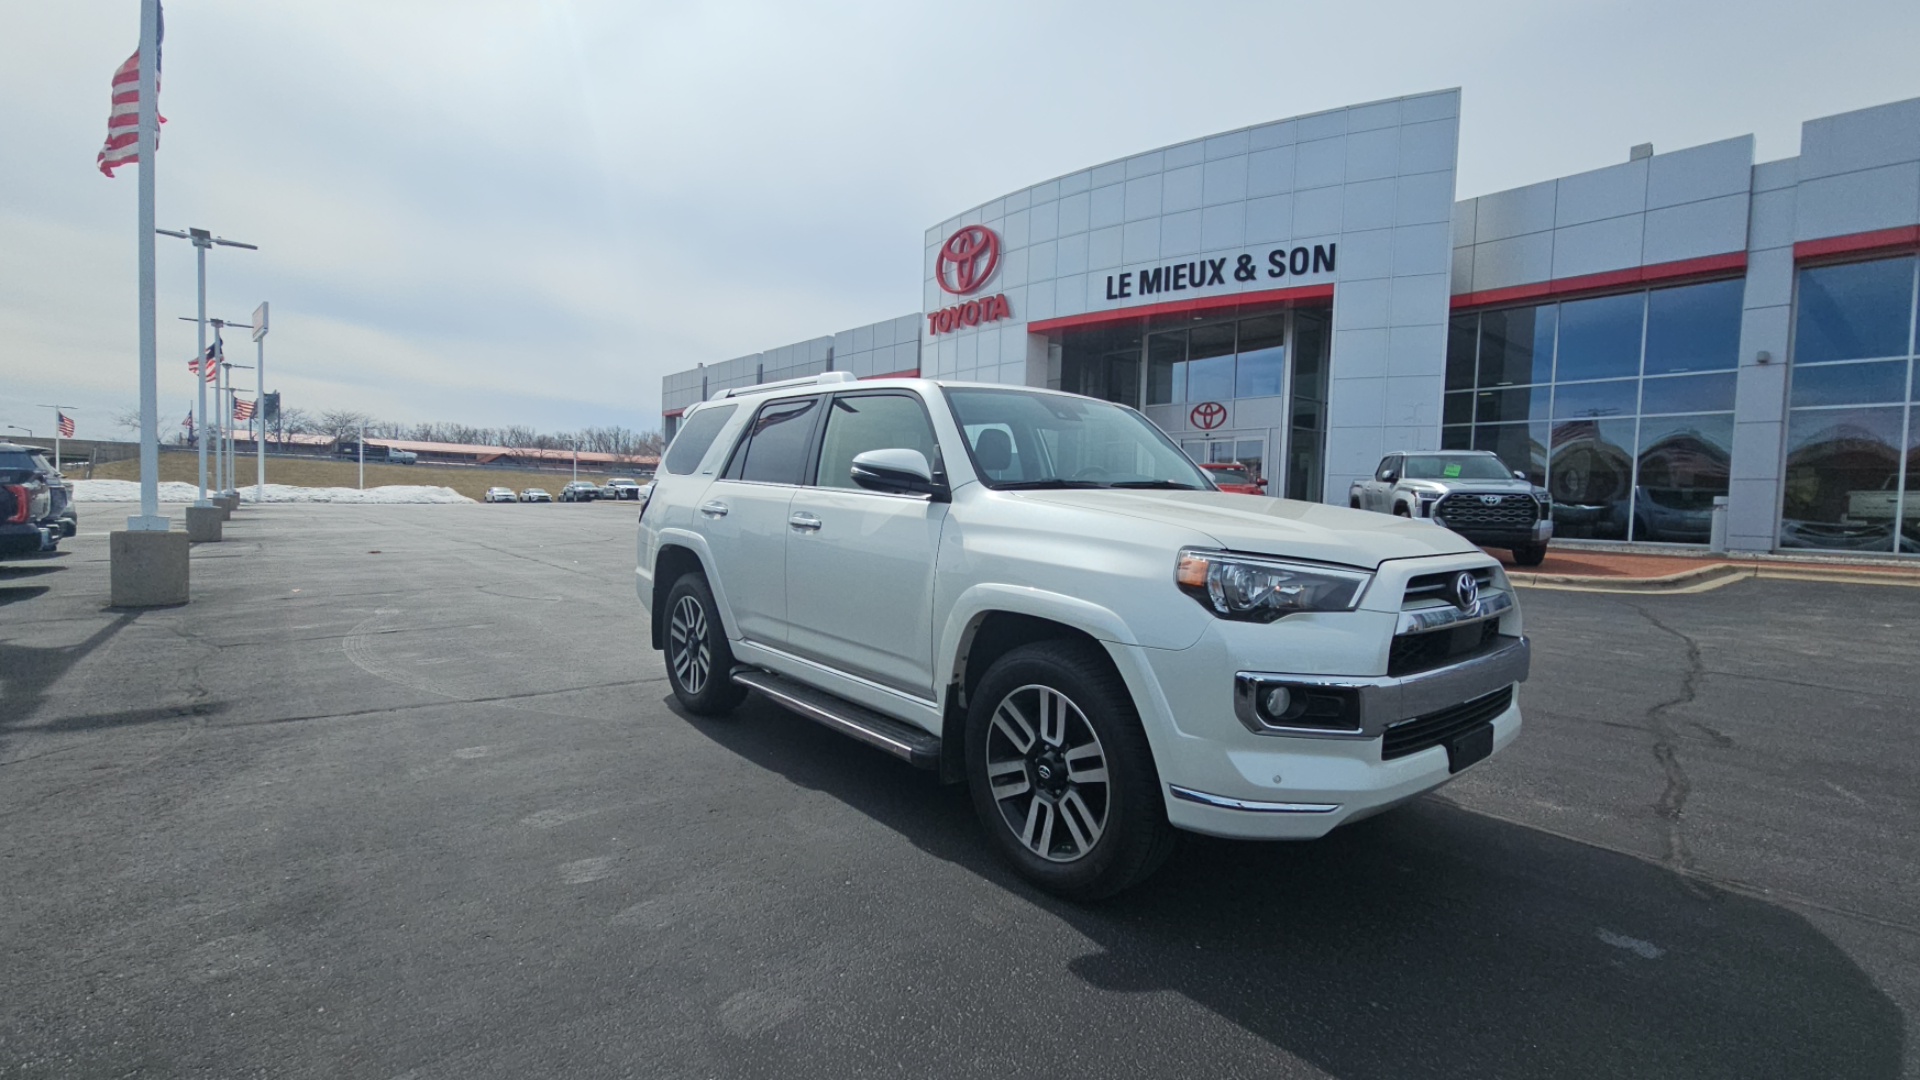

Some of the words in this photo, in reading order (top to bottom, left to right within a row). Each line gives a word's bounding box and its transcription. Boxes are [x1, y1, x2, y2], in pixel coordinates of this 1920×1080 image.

[1106, 272, 1132, 300] LE
[1139, 257, 1227, 296] MIEUX
[1233, 253, 1257, 282] &
[1267, 243, 1336, 278] SON
[927, 293, 1010, 336] TOYOTA
